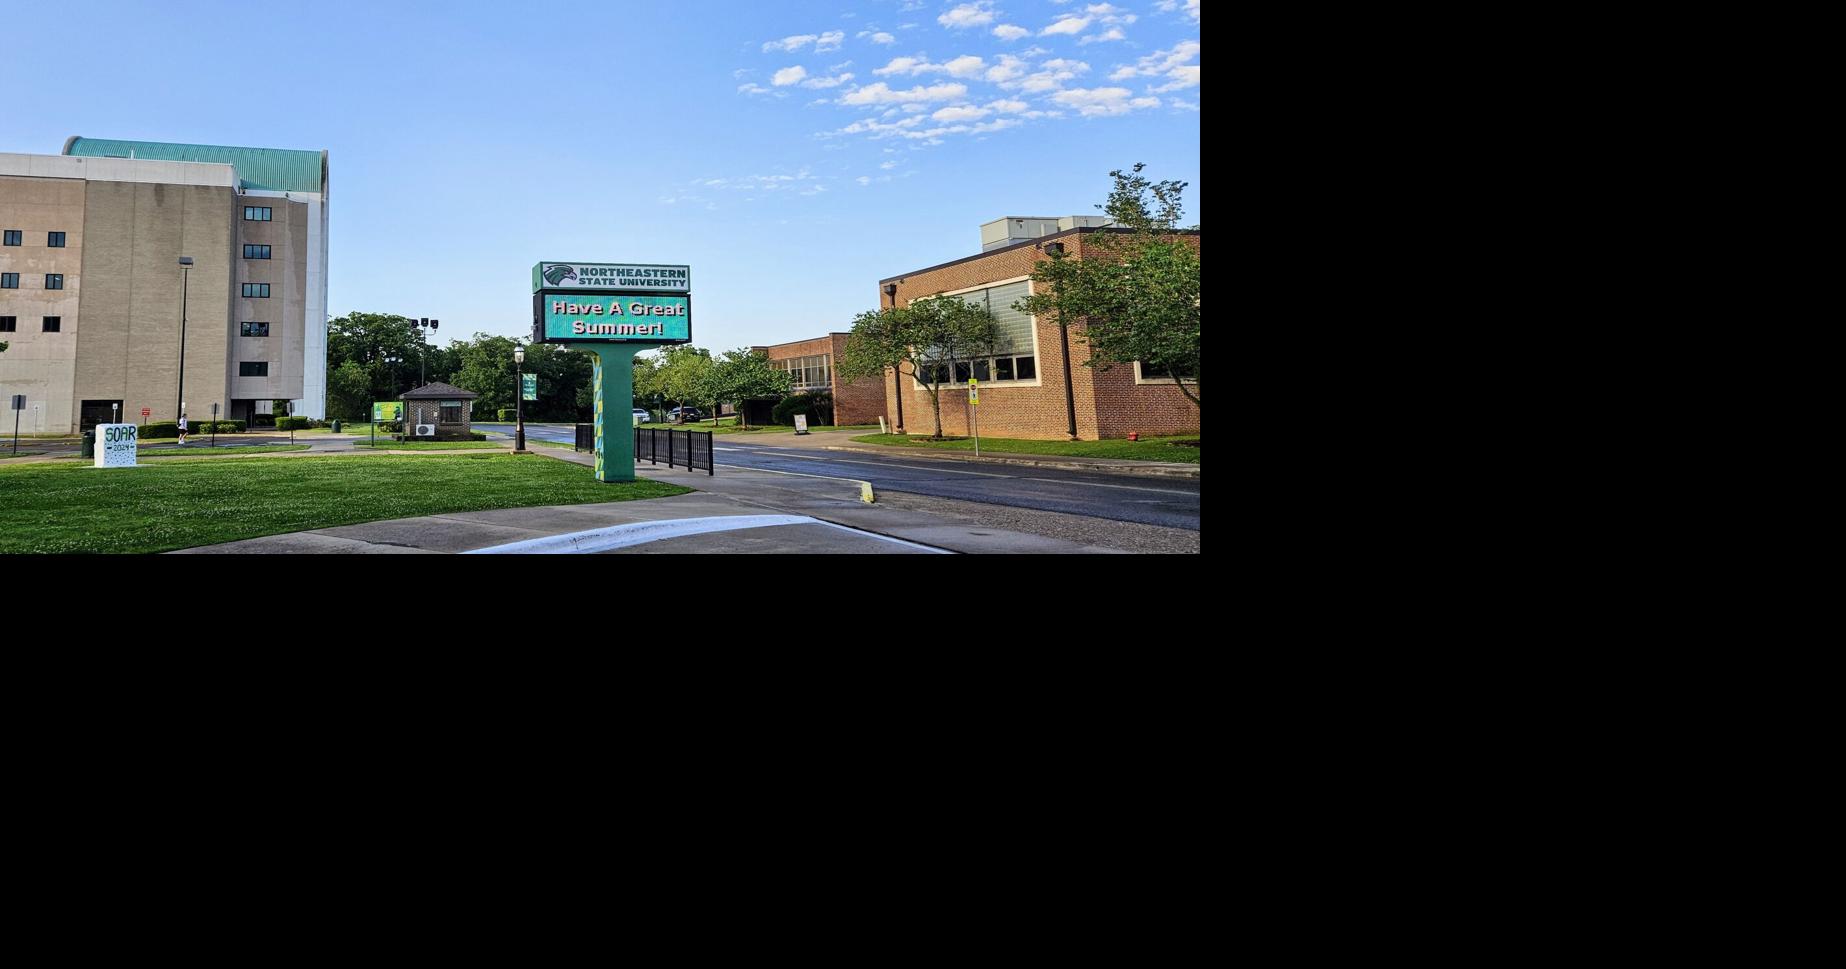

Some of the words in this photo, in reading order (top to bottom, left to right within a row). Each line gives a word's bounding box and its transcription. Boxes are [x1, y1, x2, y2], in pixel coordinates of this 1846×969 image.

[580, 267, 686, 278] NORTHEASTERN
[579, 277, 615, 286] STATE
[619, 278, 686, 287] UNIVERSITY
[552, 301, 603, 315] Have
[609, 302, 624, 315] A
[629, 302, 685, 316] Great
[572, 320, 664, 335] Summer!
[105, 426, 136, 442] SOAR
